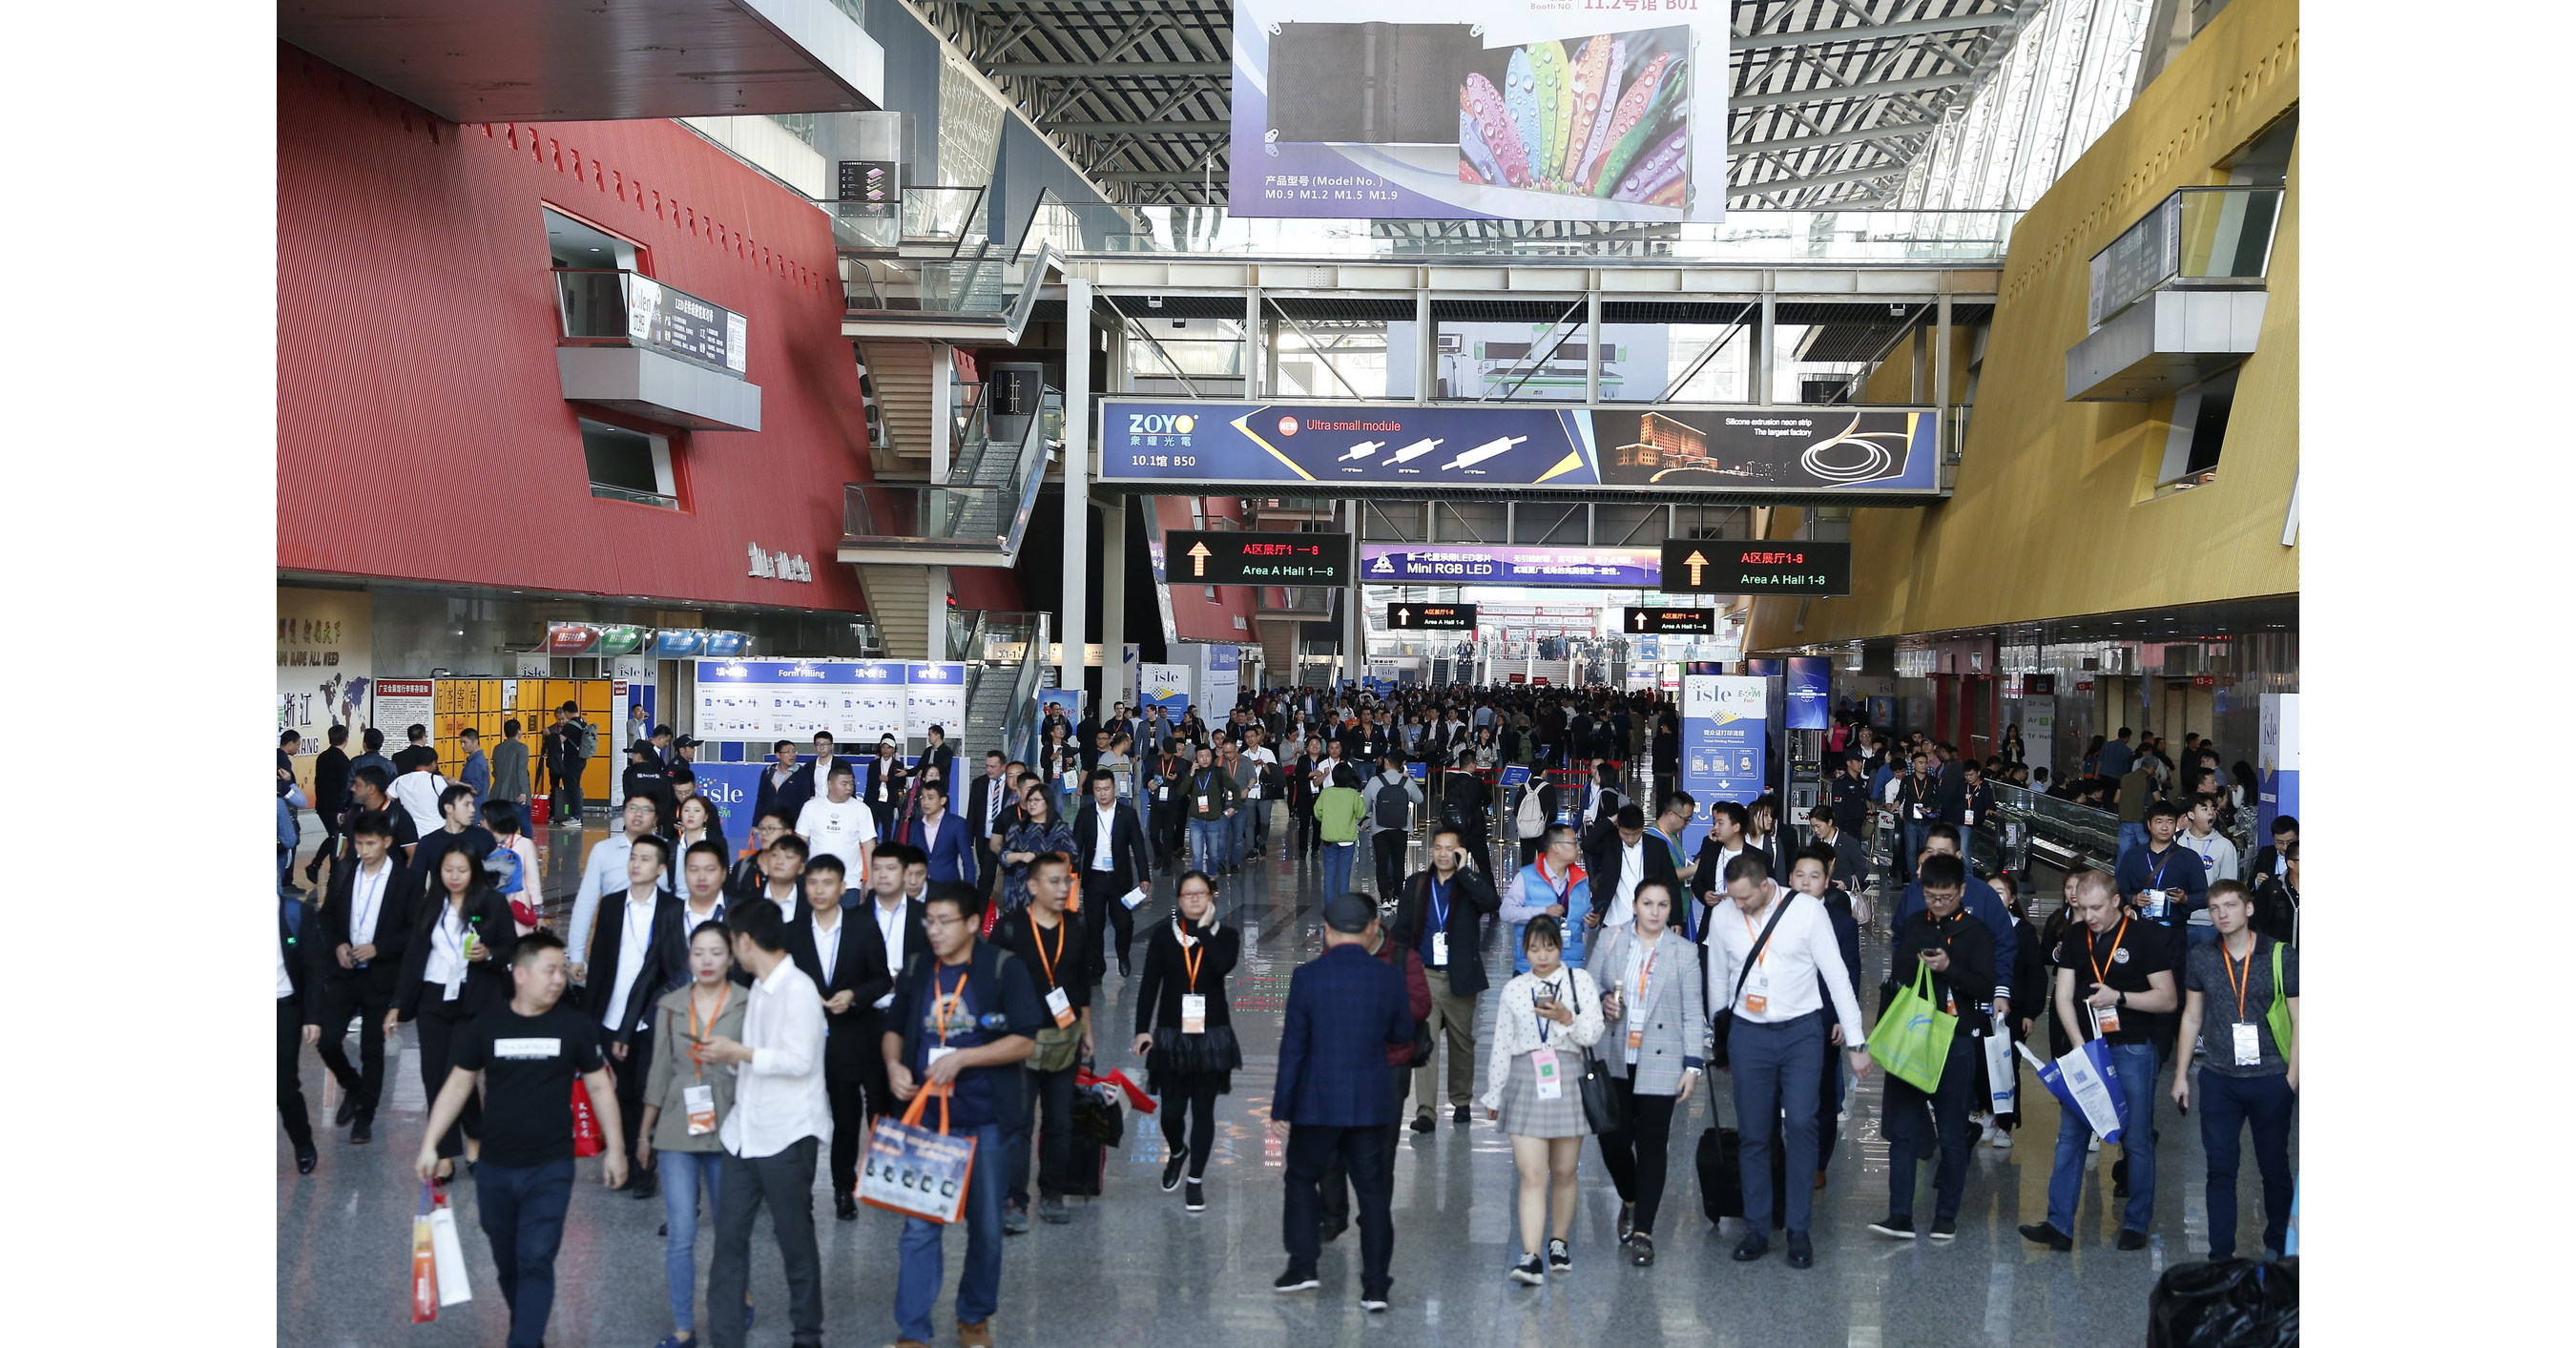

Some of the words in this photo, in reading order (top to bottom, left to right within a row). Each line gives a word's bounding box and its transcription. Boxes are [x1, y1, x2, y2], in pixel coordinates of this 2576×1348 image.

[1265, 176, 1309, 186] 产品型号
[1312, 176, 1353, 187] (Model
[1265, 190, 1294, 199] M0.9
[1300, 190, 1328, 199] M1.2
[1335, 191, 1362, 200] M1.5
[1369, 191, 1398, 200] M1.9
[1130, 414, 1195, 434] ZOYO
[1280, 422, 1298, 431] NEW
[1306, 420, 1331, 430] Ultra
[1334, 420, 1361, 430] small
[1363, 421, 1401, 431] module
[1768, 428, 1789, 437] largest
[1790, 428, 1812, 437] factory
[1132, 455, 1168, 467] 10.1馆
[1174, 456, 1195, 467] B50
[1741, 552, 1803, 564] A区展厅1-8
[1242, 566, 1268, 574] Area
[1272, 566, 1279, 575] A
[1283, 566, 1304, 576] Hall
[1406, 563, 1432, 573] Mini
[1435, 563, 1464, 574] RGB
[1466, 564, 1492, 574] LED
[1741, 574, 1767, 584] Area
[1771, 574, 1779, 584] A
[1783, 574, 1804, 585] Hall
[1808, 575, 1825, 585] 1-8
[309, 651, 322, 667] ALL
[323, 651, 339, 667] NEED
[522, 666, 545, 677] isle
[620, 666, 640, 676] isle
[801, 668, 825, 678] Filling
[1154, 671, 1178, 682] isle
[1695, 685, 1732, 702] isle
[283, 693, 312, 727] 浙江
[2263, 714, 2277, 745] isle
[701, 783, 744, 803] isle
